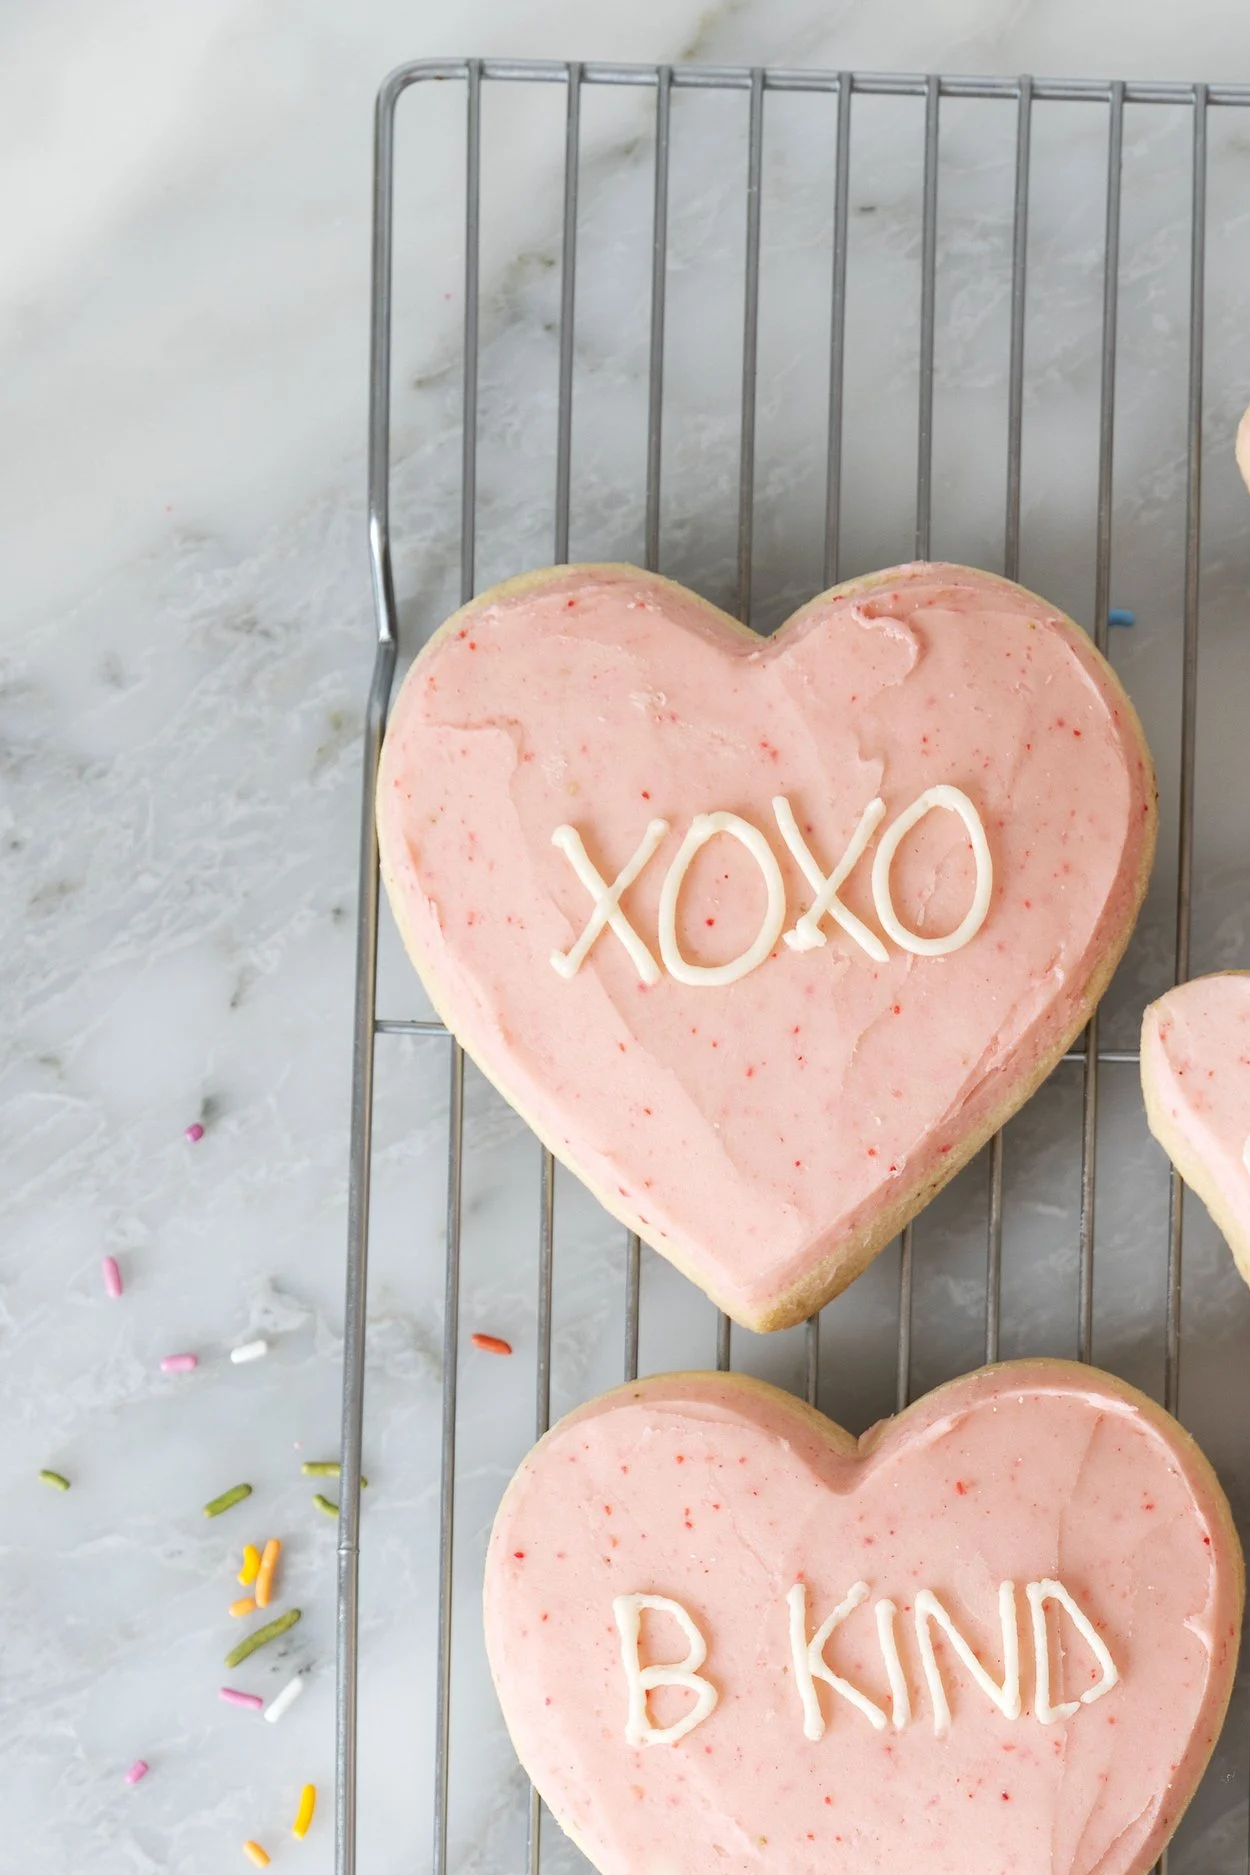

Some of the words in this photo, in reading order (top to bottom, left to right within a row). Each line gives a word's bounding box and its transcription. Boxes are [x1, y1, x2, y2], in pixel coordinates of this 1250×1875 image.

[549, 785, 994, 987] XOXO
[613, 1591, 718, 1747] B
[787, 1577, 1120, 1741] KIND
